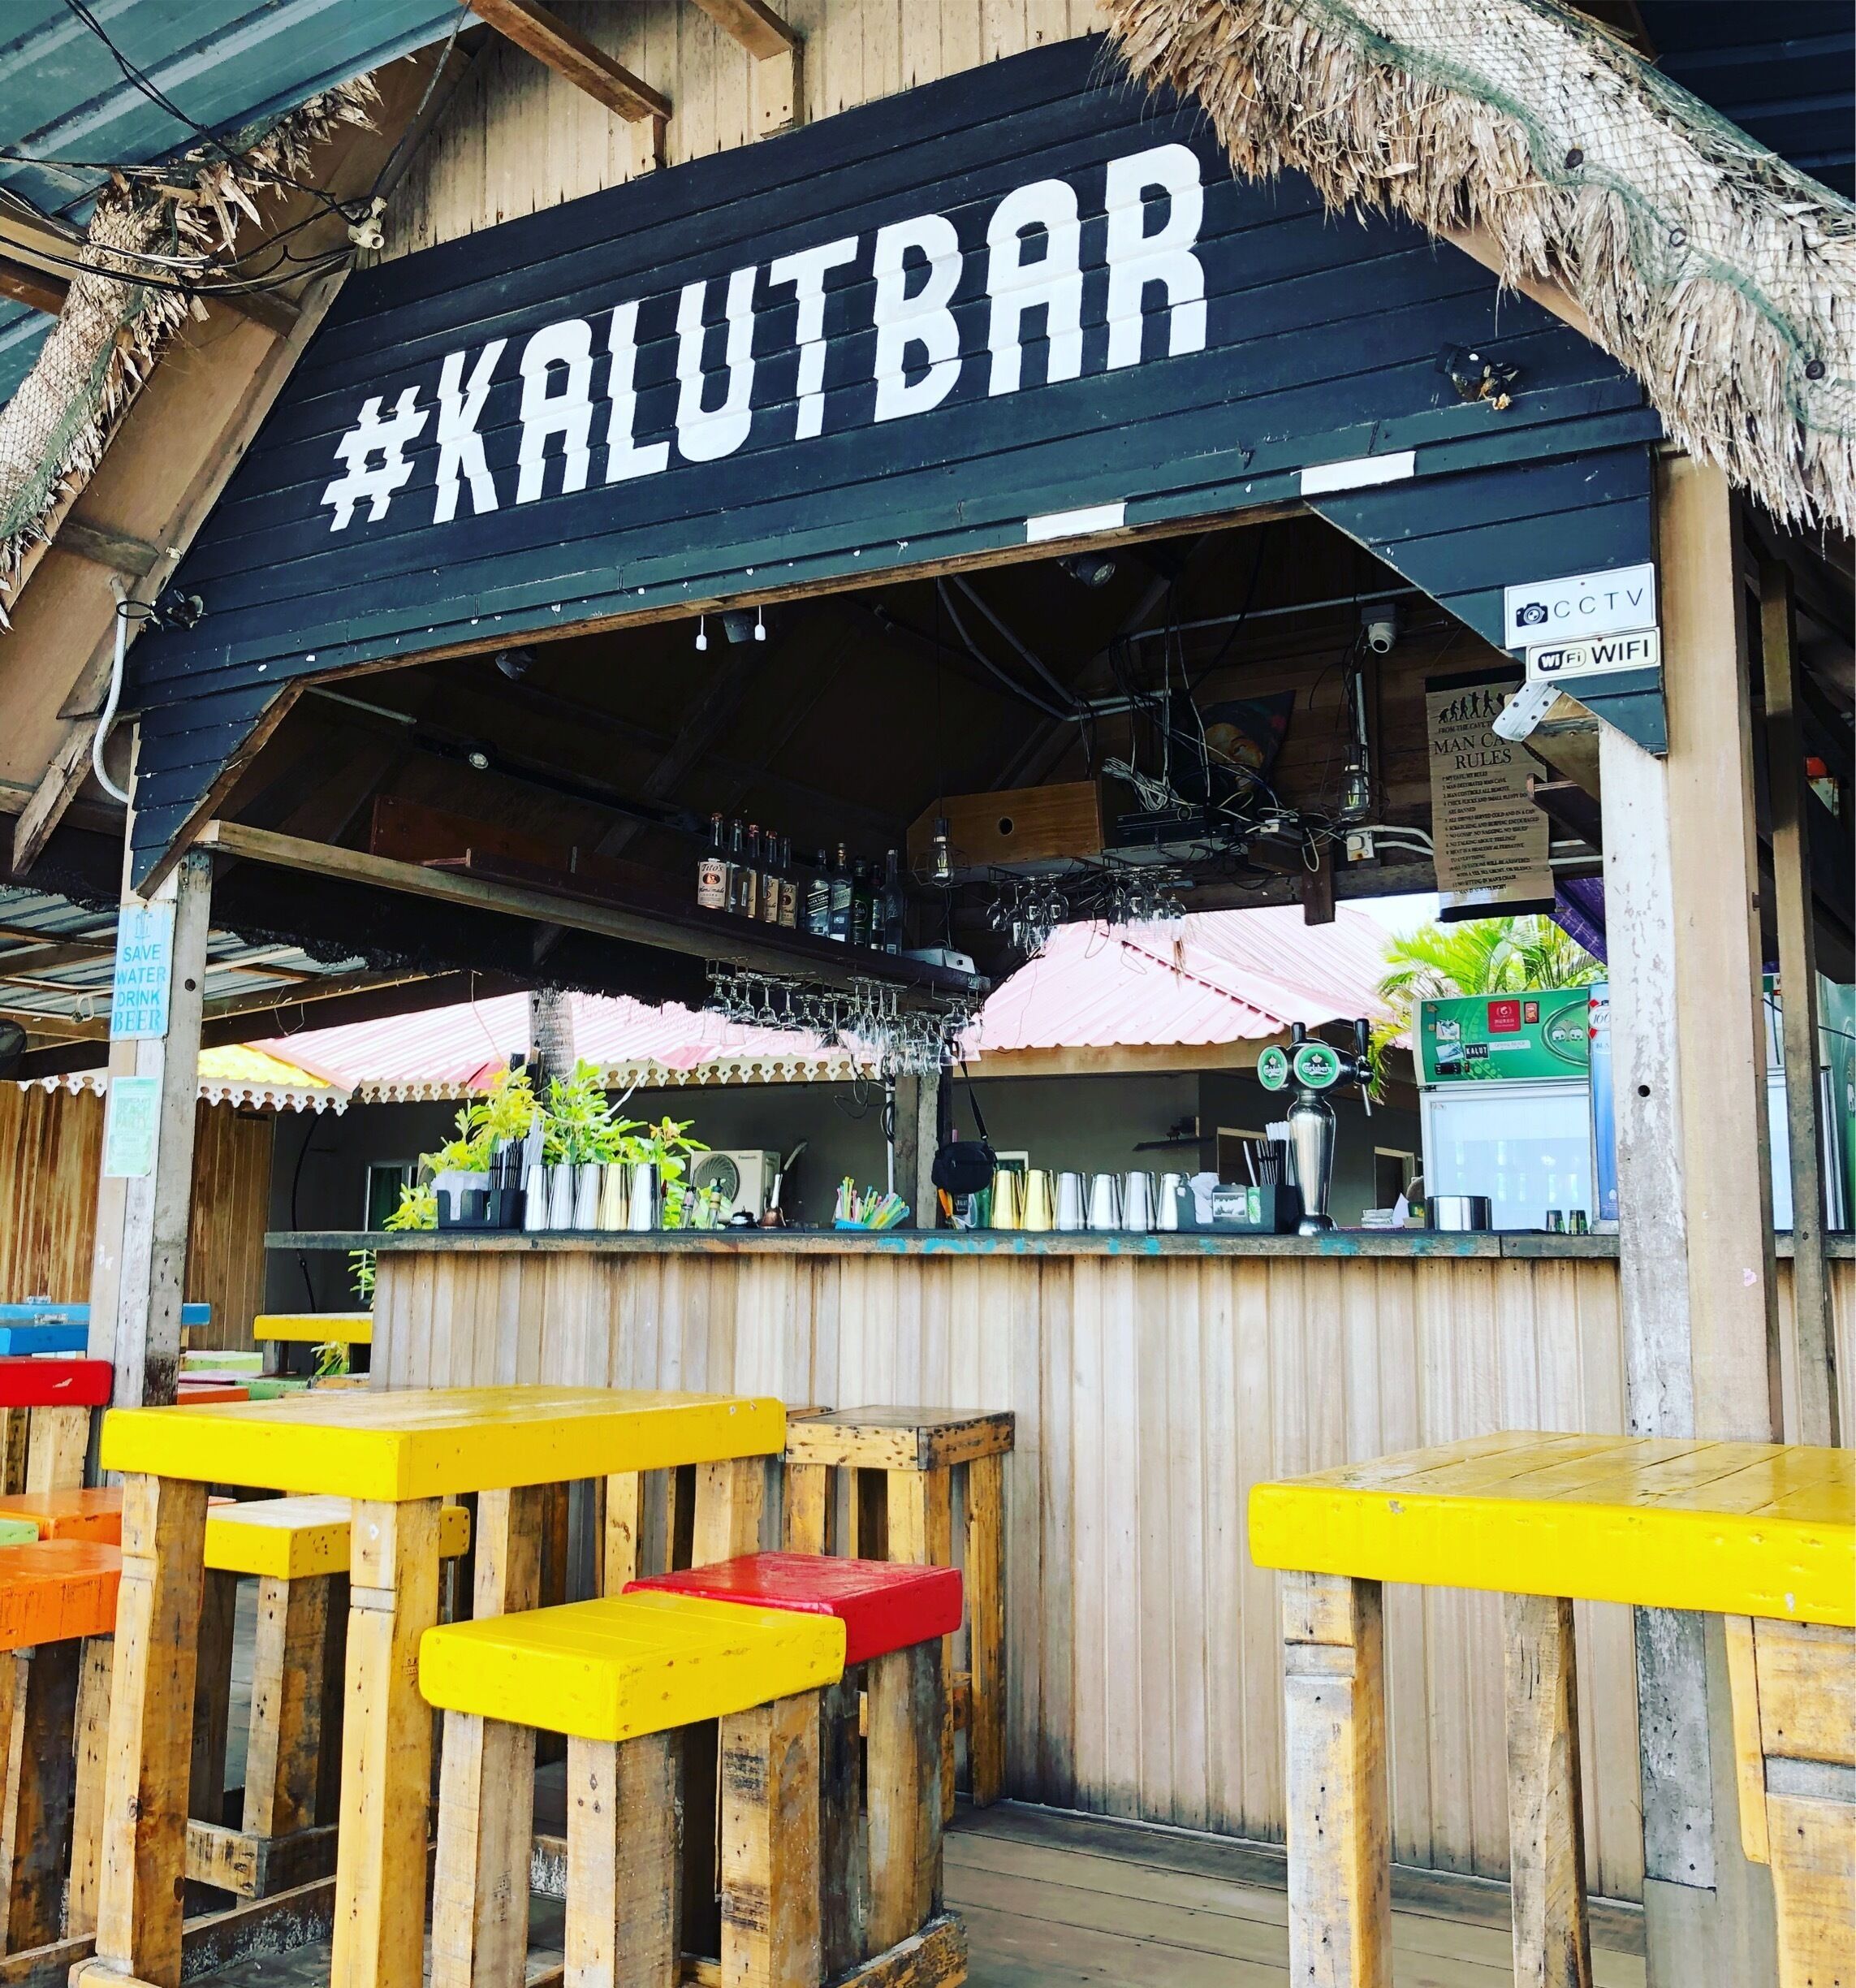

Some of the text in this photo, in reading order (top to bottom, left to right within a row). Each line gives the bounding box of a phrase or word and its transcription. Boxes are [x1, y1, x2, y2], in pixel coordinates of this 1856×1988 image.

[321, 143, 1207, 532] #KALUTBAR
[1554, 588, 1643, 618] CCTV
[1591, 639, 1649, 664] WIFI
[1434, 735, 1475, 754] MAN
[1454, 748, 1512, 769] RULES
[701, 863, 724, 872] Tito's
[123, 944, 162, 962] SAVE
[117, 966, 166, 985] WATER
[117, 988, 162, 1007] DRINK
[113, 1009, 162, 1032] BEER
[1465, 1046, 1487, 1055] KALUT
[1301, 1062, 1333, 1076] Carlsberg
